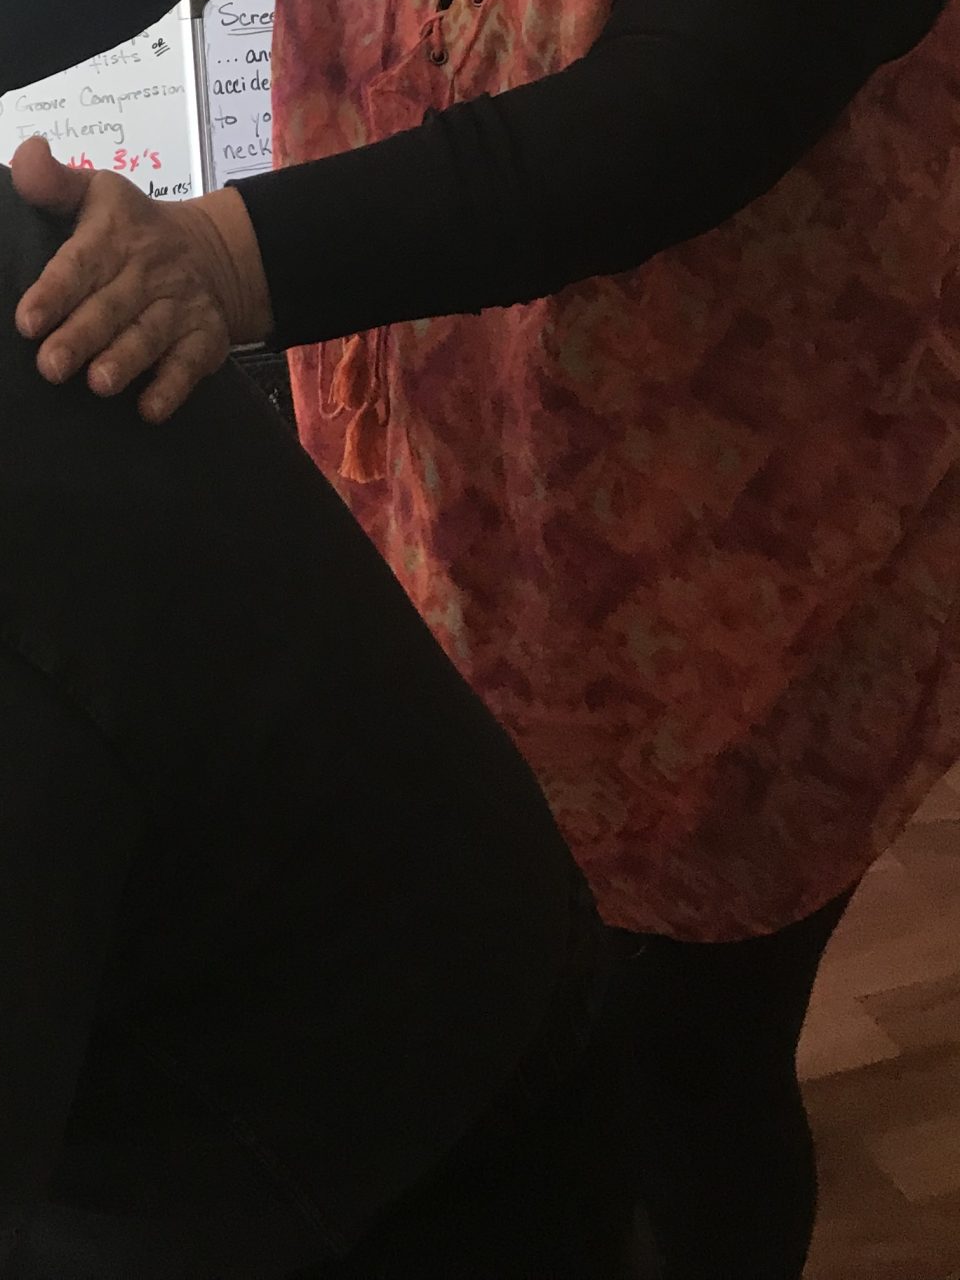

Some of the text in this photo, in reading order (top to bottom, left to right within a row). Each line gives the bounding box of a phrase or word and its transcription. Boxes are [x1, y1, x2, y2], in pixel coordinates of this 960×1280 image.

[15, 95, 66, 112] Groove
[80, 84, 184, 113] Compression
[214, 105, 237, 129] to
